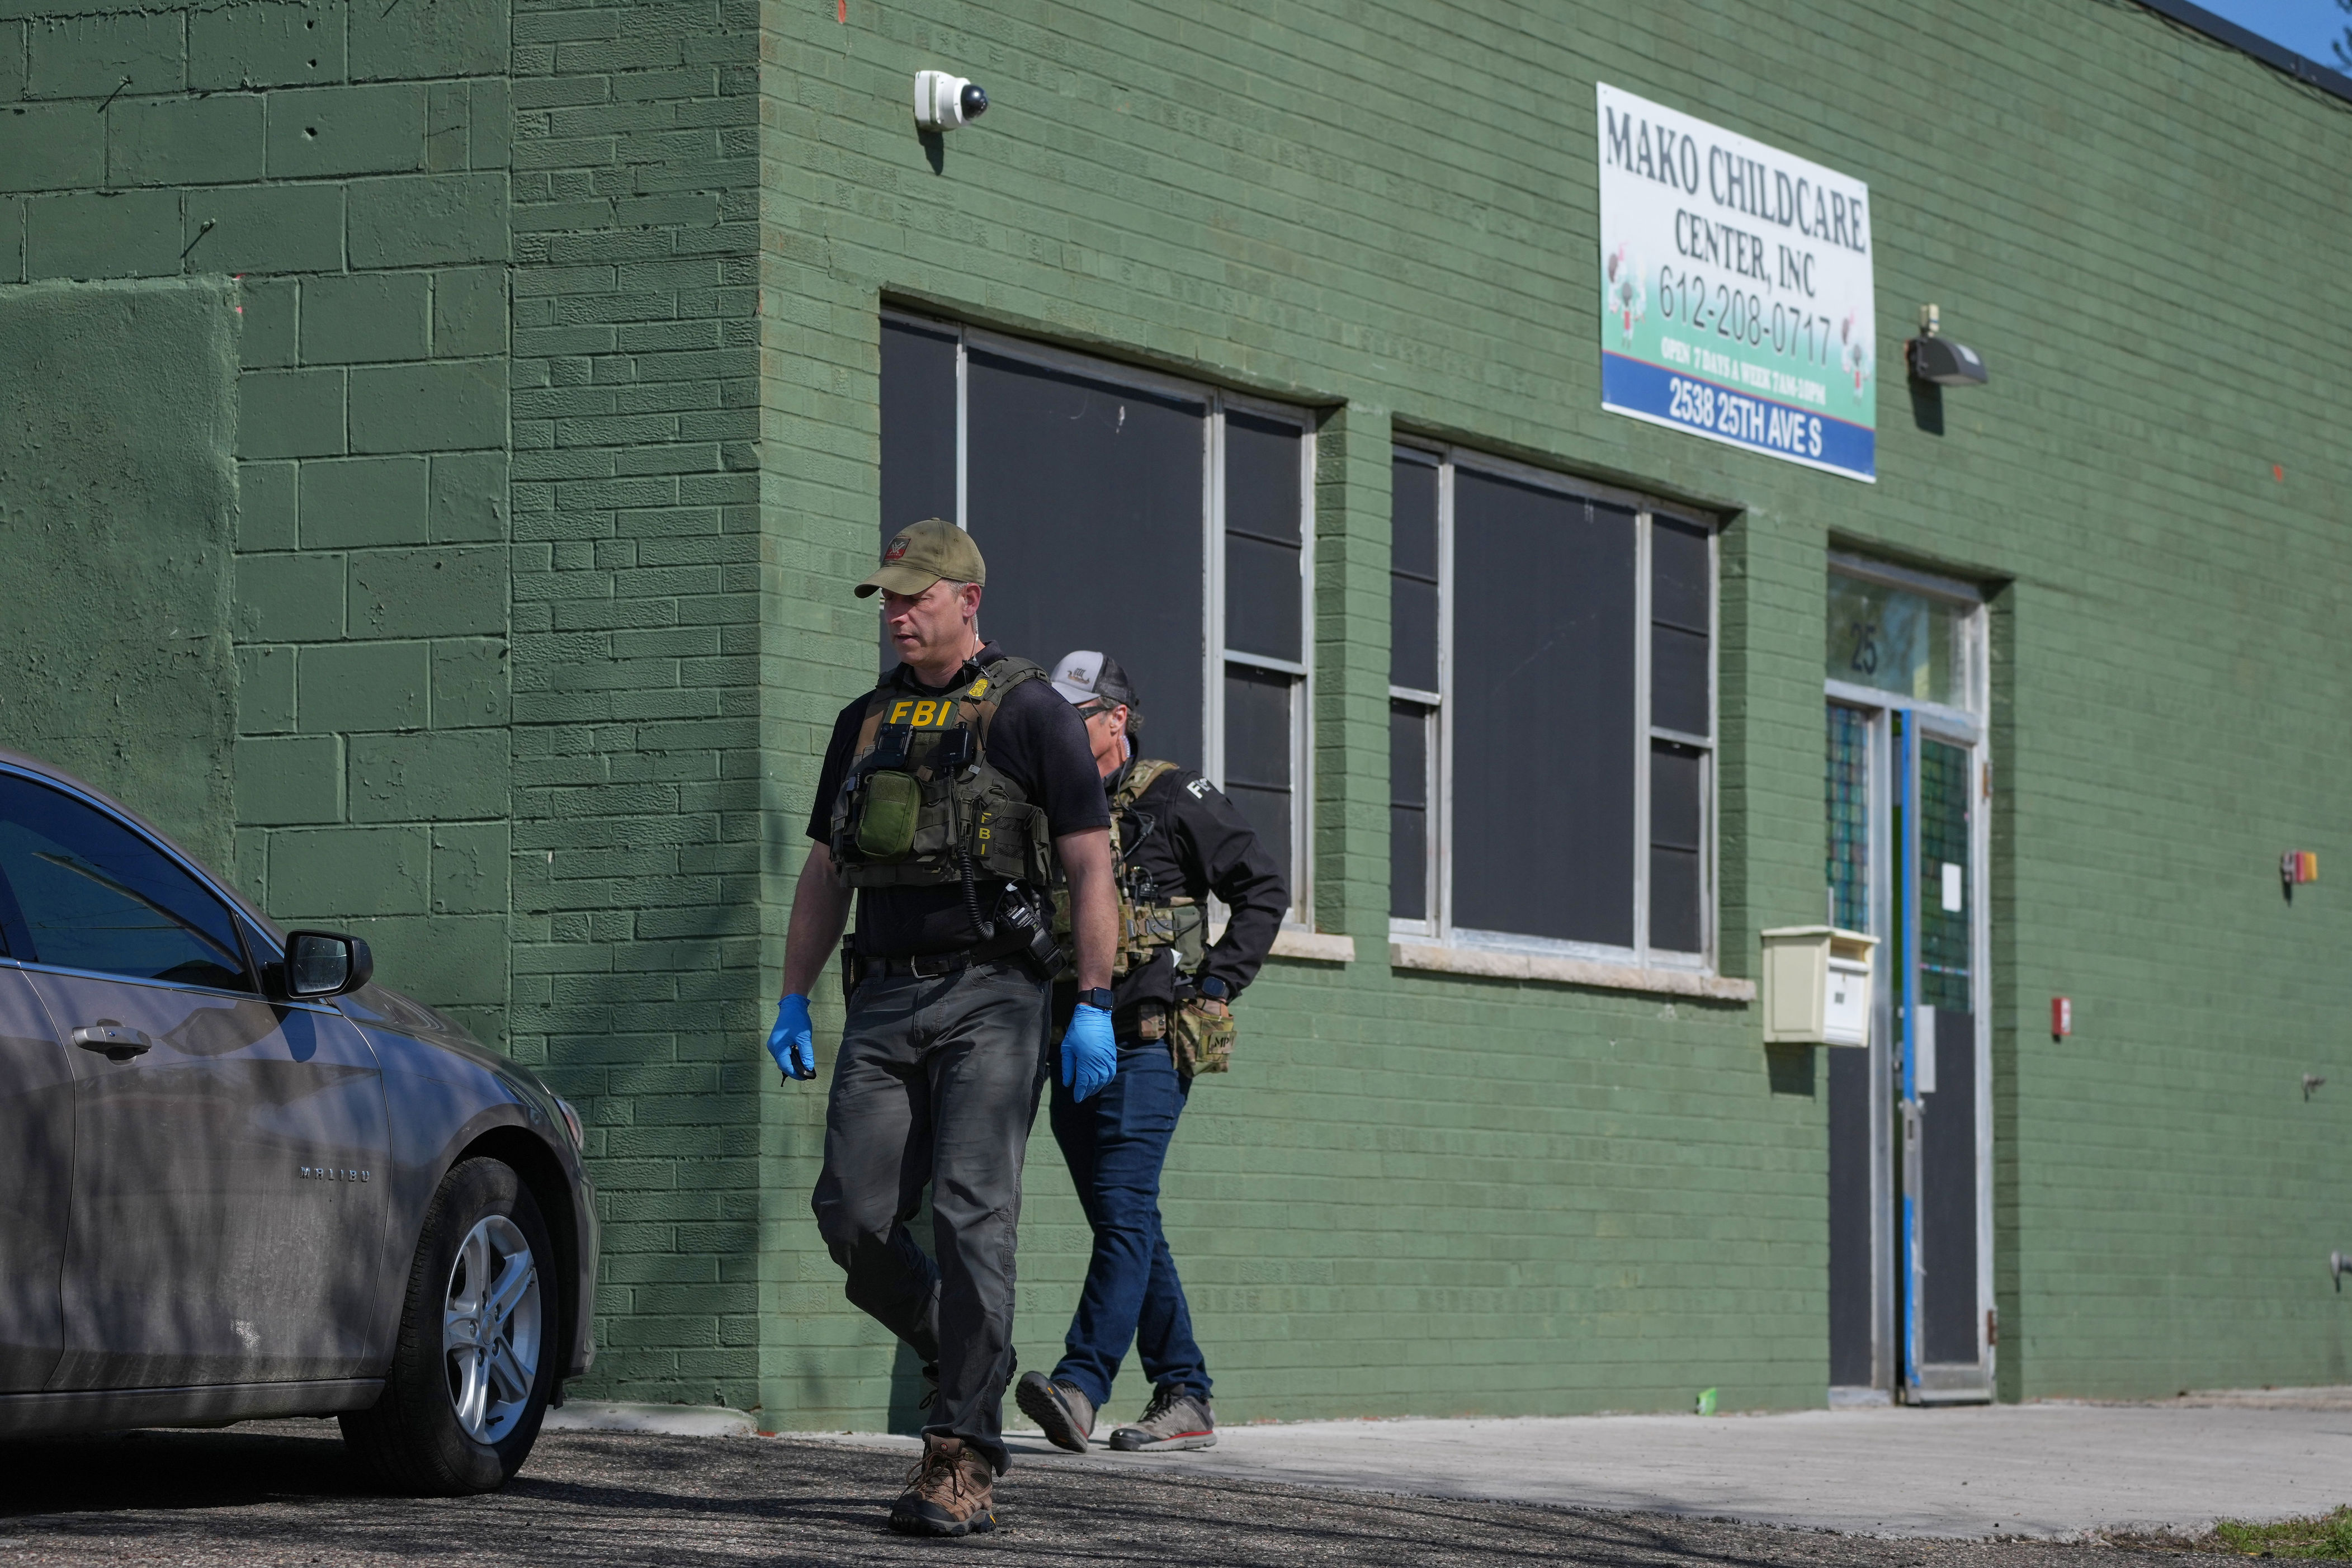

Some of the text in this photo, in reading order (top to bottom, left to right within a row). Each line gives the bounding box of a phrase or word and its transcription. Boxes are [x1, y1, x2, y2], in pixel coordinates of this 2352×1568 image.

[1606, 105, 1866, 254] MAKO CHILDCARE
[1675, 207, 1815, 298] CENTER, INC
[1659, 265, 1831, 366] 612-208-0717
[1661, 337, 1690, 365] OPEN
[1702, 350, 1731, 379] DAYS
[1740, 361, 1772, 390] WEEK
[1669, 377, 1823, 457] 2538 25TH AVE S
[889, 701, 952, 726] FBI
[979, 812, 992, 855] FBI
[300, 1166, 370, 1182] MALIBU
